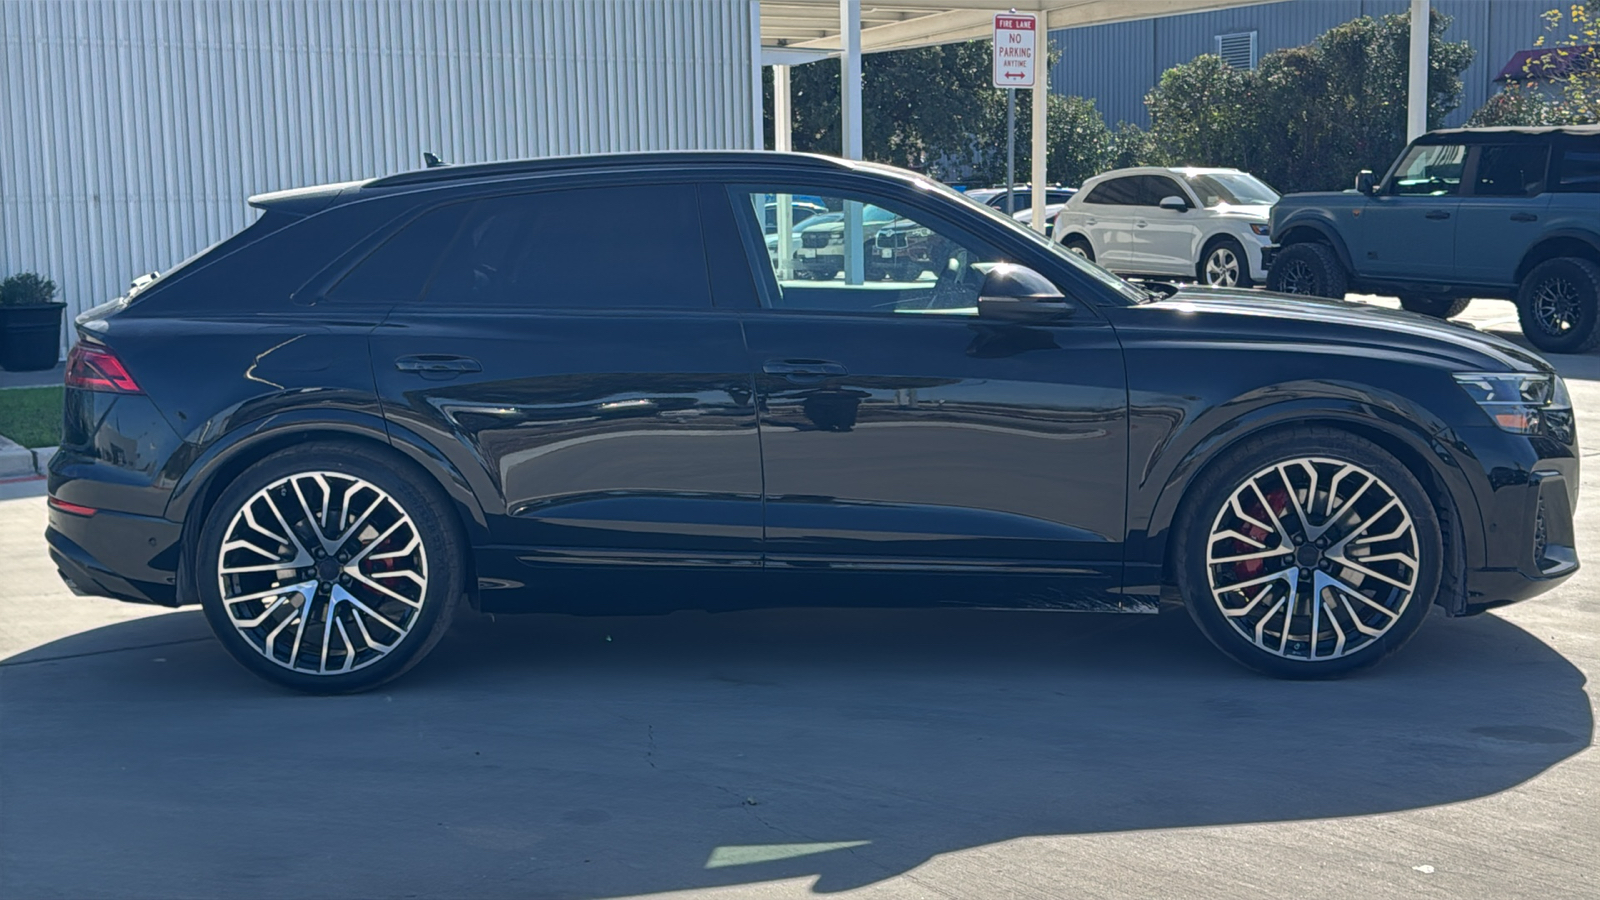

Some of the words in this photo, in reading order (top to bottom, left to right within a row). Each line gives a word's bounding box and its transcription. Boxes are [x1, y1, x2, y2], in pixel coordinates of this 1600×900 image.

[999, 19, 1013, 28] FIRE
[1015, 20, 1032, 29] LANE
[1009, 33, 1022, 44] NO
[999, 46, 1031, 58] PARKING
[1003, 60, 1027, 68] ANYTIME
